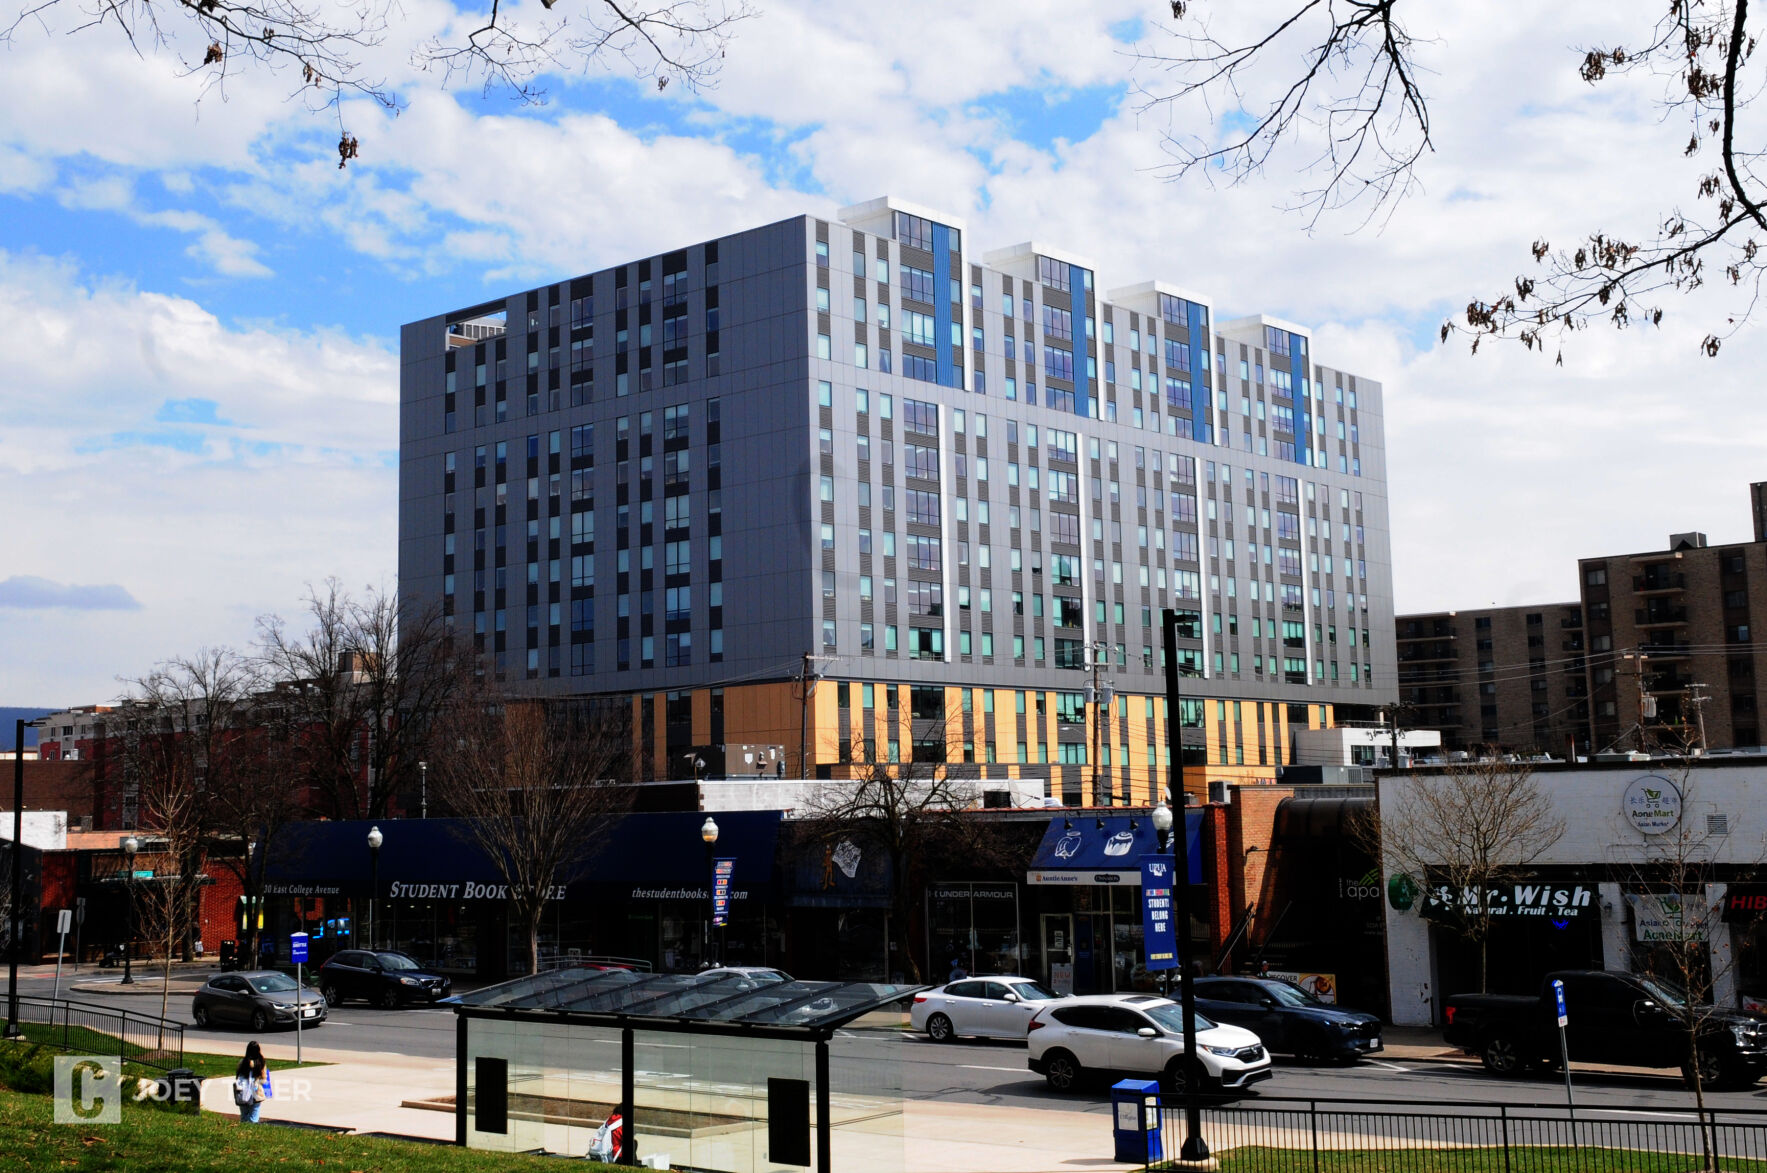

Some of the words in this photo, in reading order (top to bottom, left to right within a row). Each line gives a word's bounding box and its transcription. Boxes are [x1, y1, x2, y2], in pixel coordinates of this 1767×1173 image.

[273, 884, 288, 894] East
[289, 884, 313, 896] College
[315, 885, 340, 894] Avenue
[389, 881, 459, 899] STUDENT
[463, 881, 509, 899] BOOK
[940, 890, 970, 898] UNDER
[973, 890, 1014, 899] ARMOUR
[1514, 885, 1591, 907] Wish
[1151, 910, 1169, 921] BELONG
[1517, 905, 1546, 916] Fruit
[1557, 906, 1578, 916] Tea
[1154, 922, 1167, 932] HERE
